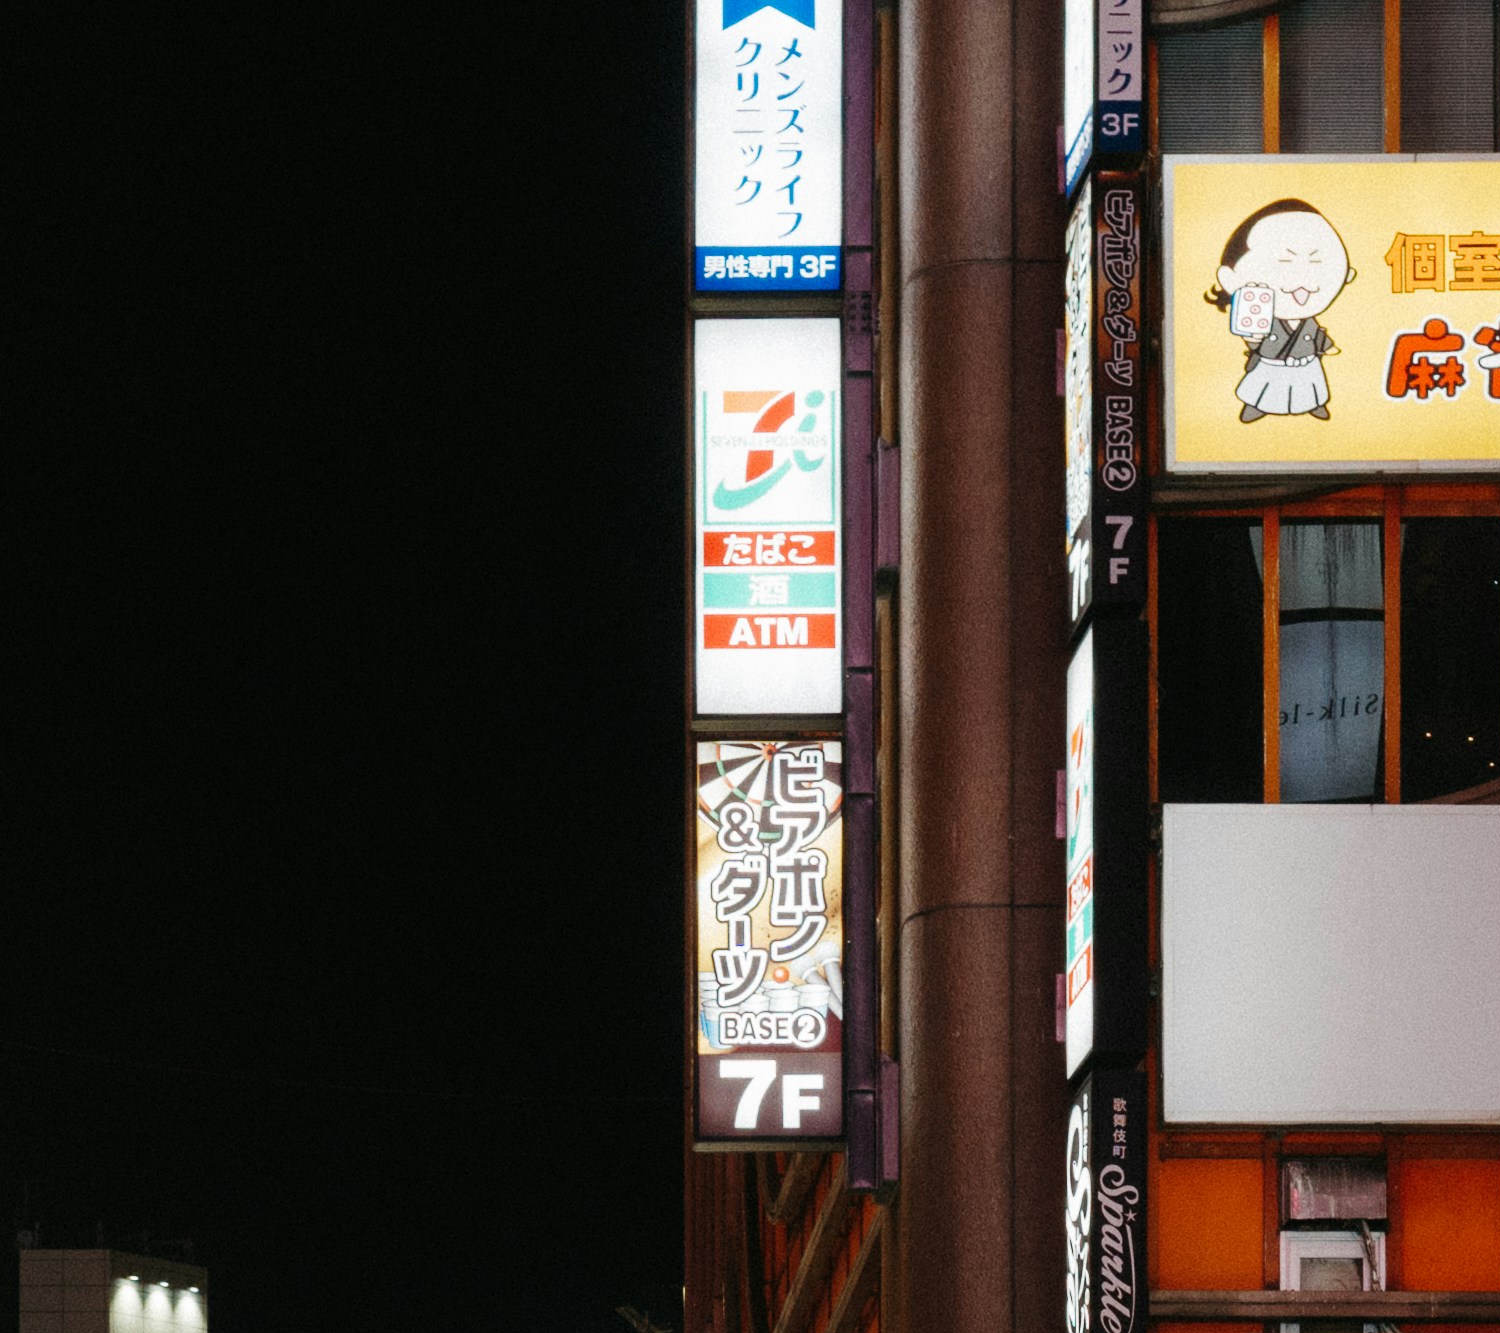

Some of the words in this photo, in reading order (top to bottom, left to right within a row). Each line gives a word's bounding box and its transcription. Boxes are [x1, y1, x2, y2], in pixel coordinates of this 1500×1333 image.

[733, 37, 764, 206] クリニック
[774, 37, 807, 239] メンズライフ
[703, 254, 794, 279] 男性専門
[722, 533, 816, 566] たばこ
[728, 616, 808, 646] ATM
[770, 748, 828, 962] ビアポン
[1112, 1096, 1127, 1160] 歌舞伎町
